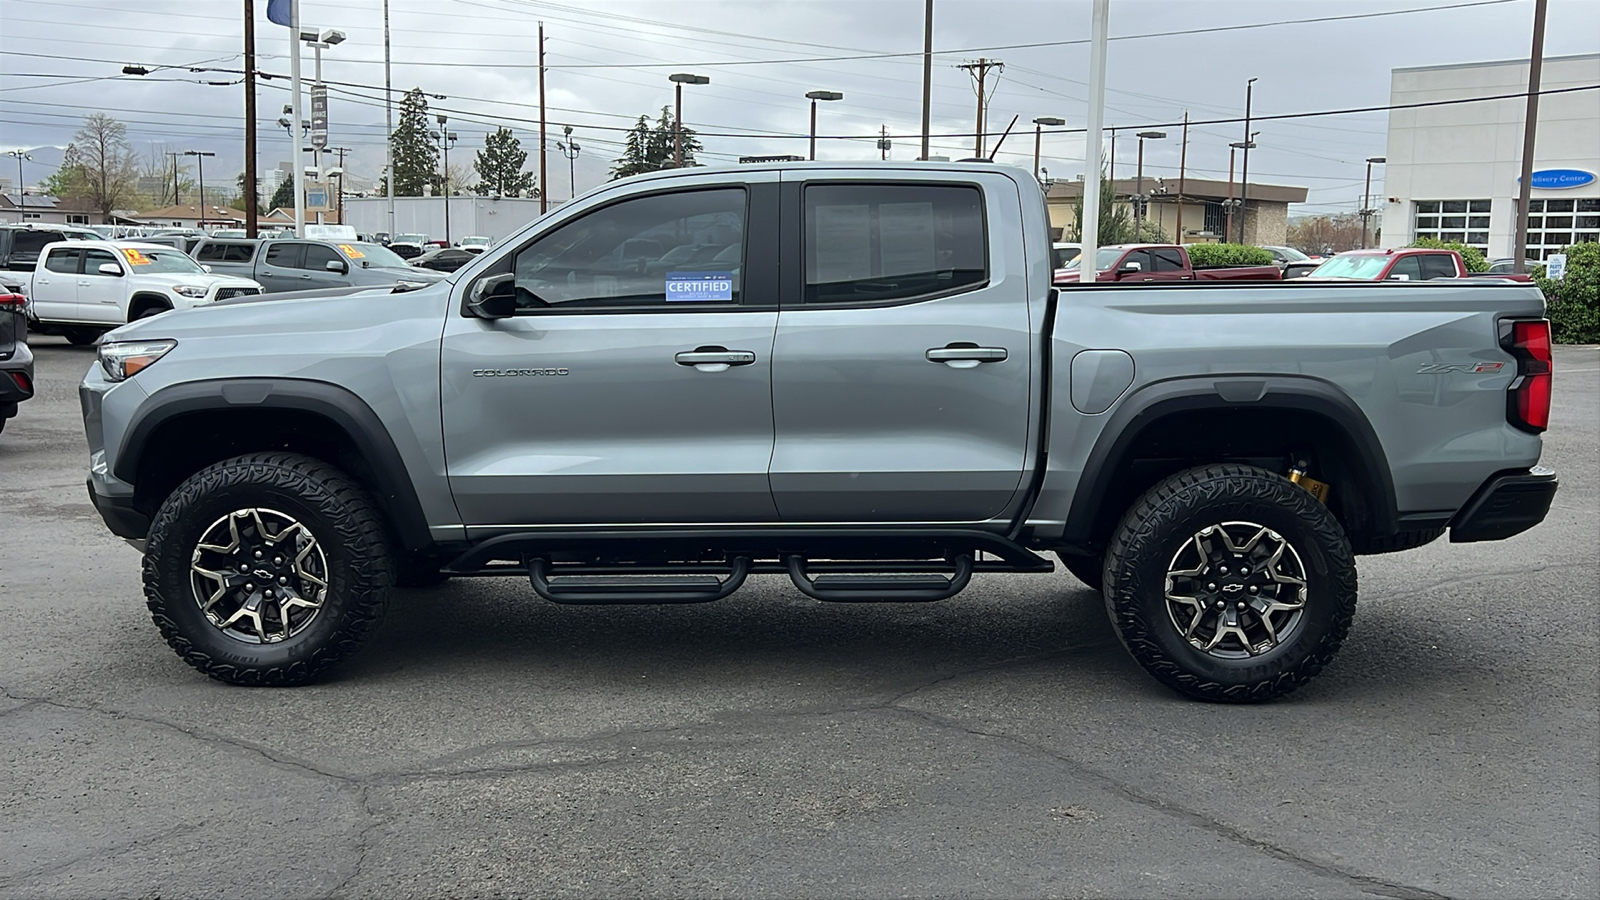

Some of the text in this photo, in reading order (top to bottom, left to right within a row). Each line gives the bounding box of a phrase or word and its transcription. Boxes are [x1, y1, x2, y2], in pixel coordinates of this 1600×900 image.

[122, 248, 140, 259] 19
[338, 244, 356, 254] 21
[668, 282, 729, 292] CERTIFIED
[473, 368, 570, 377] COLORADO
[1416, 362, 1505, 375] ZR2
